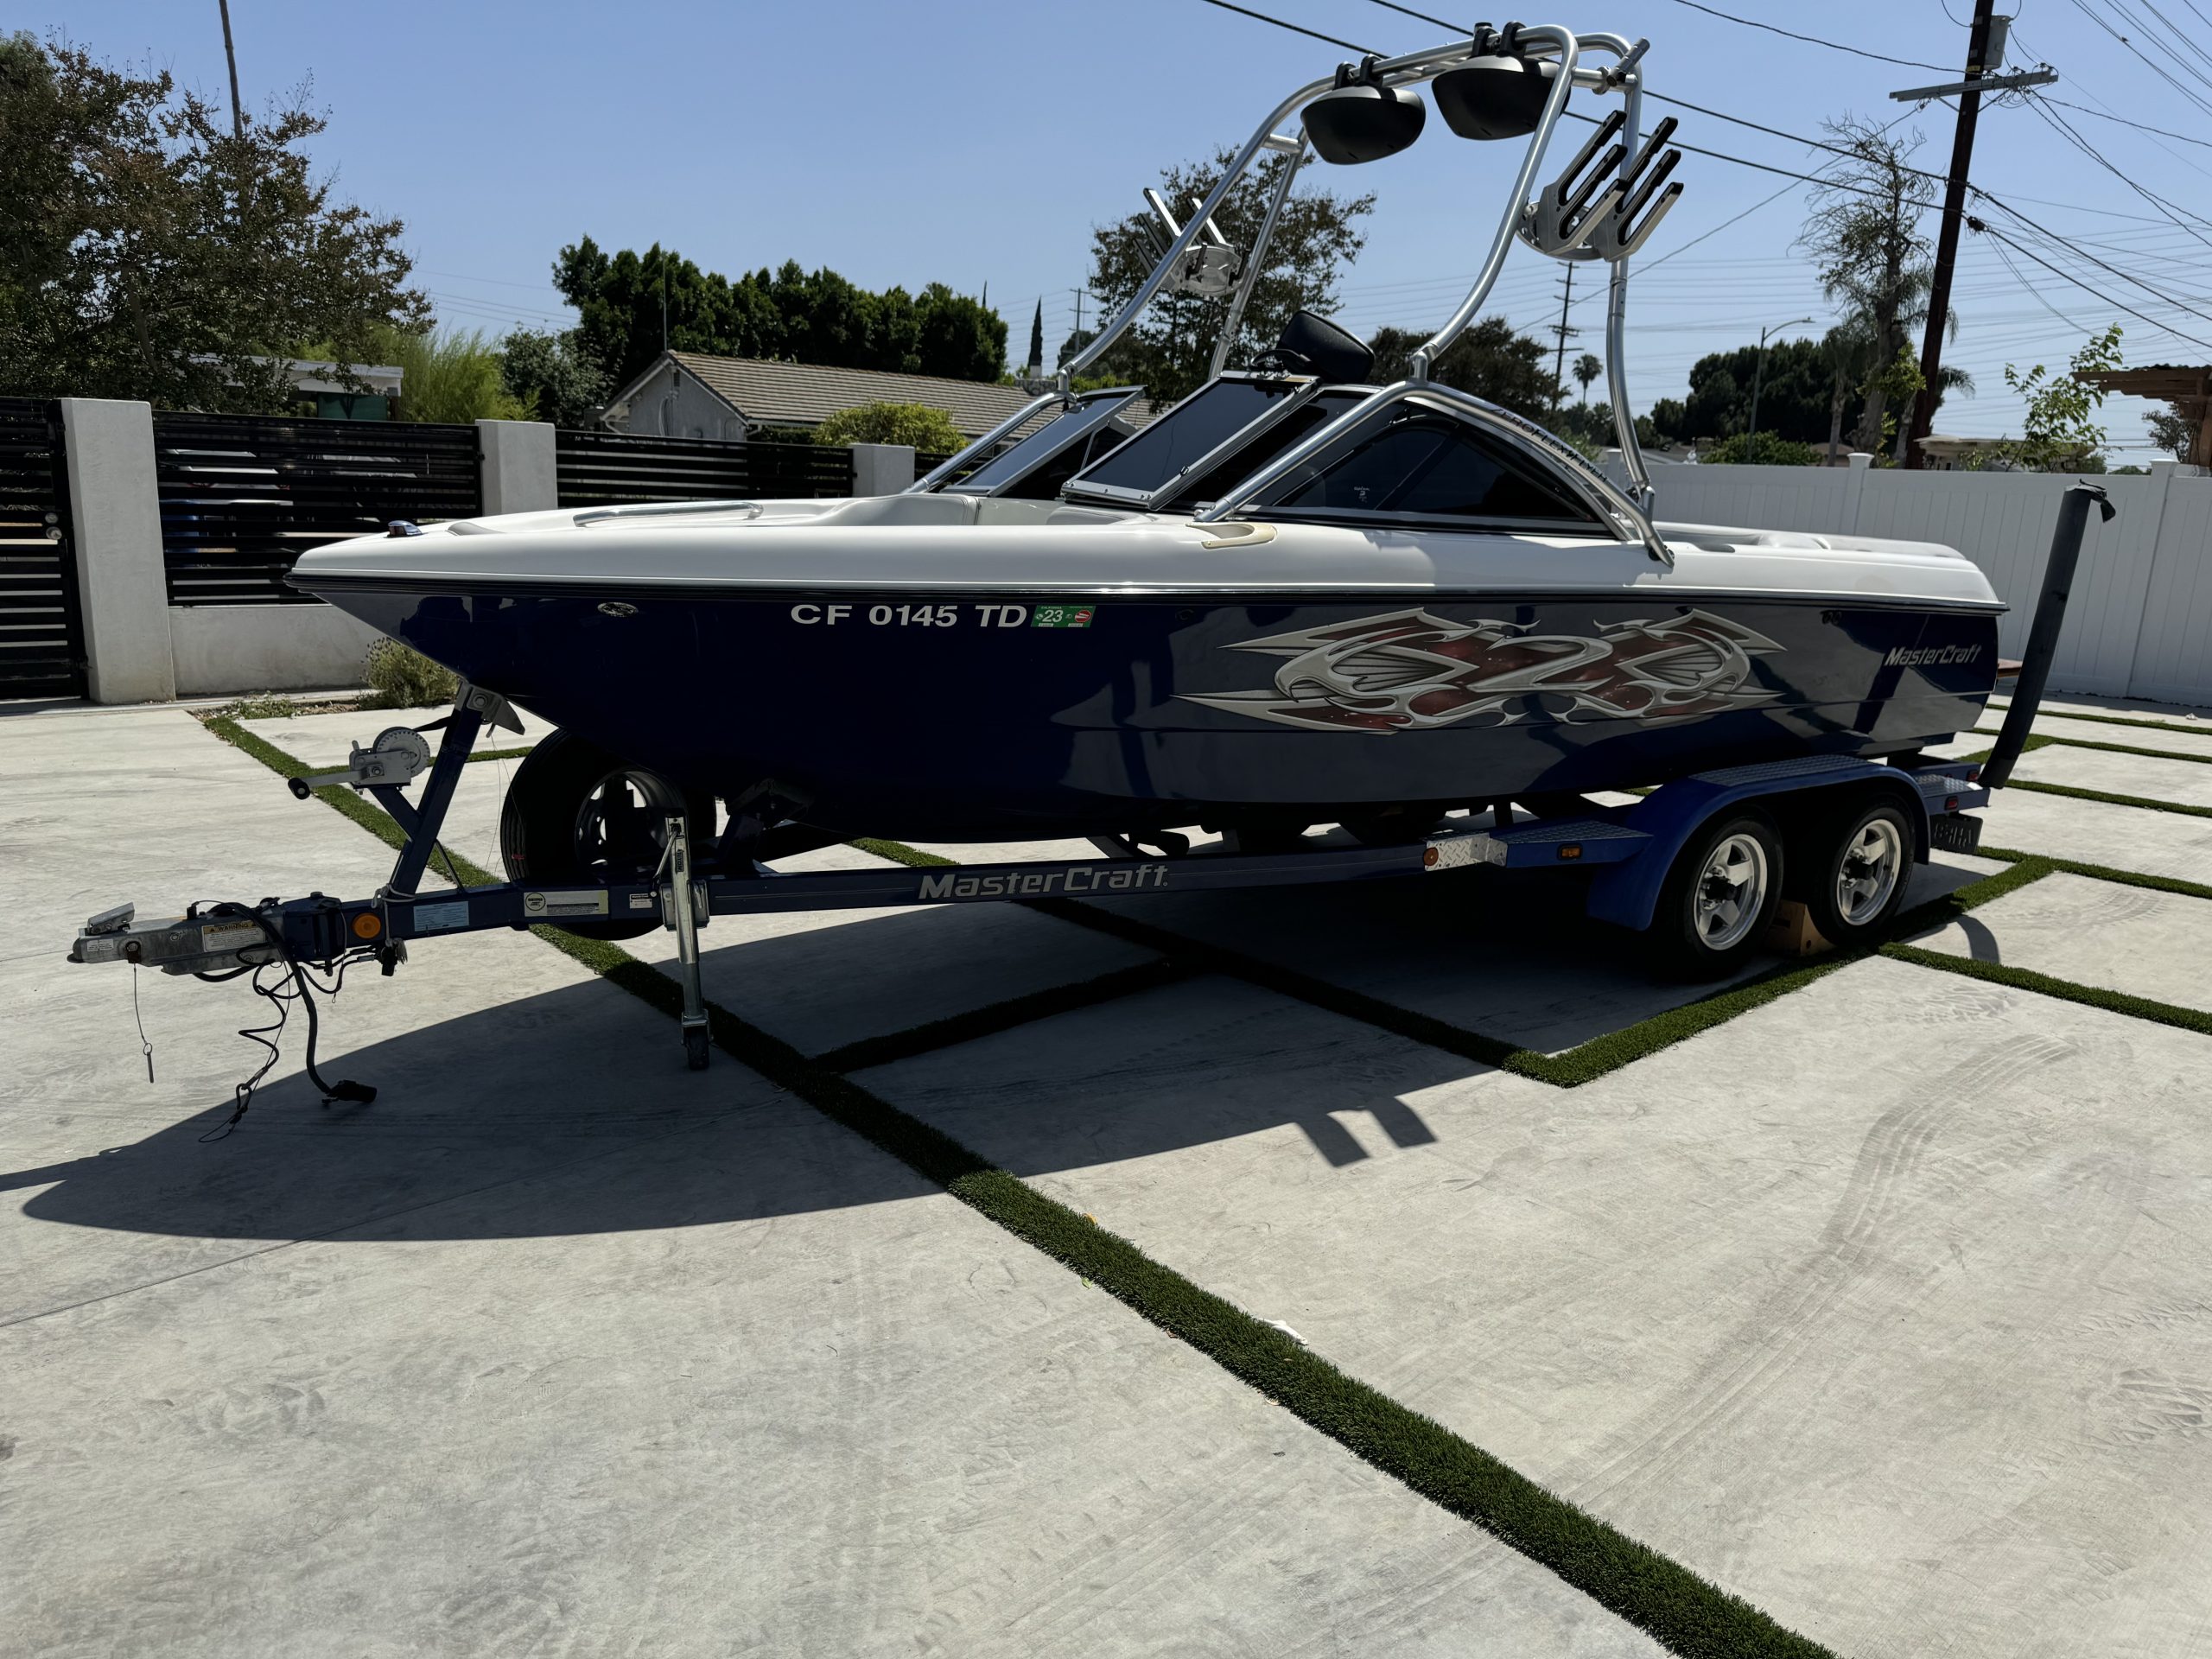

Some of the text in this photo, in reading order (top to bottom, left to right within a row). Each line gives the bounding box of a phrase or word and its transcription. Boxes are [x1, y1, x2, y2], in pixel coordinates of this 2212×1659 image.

[790, 604, 1027, 628] CF 0145 TD
[1042, 609, 1064, 623] 23
[1884, 644, 1982, 666] MasterCraft
[918, 865, 1167, 899] MasterCraft
[218, 923, 249, 931] WARNING
